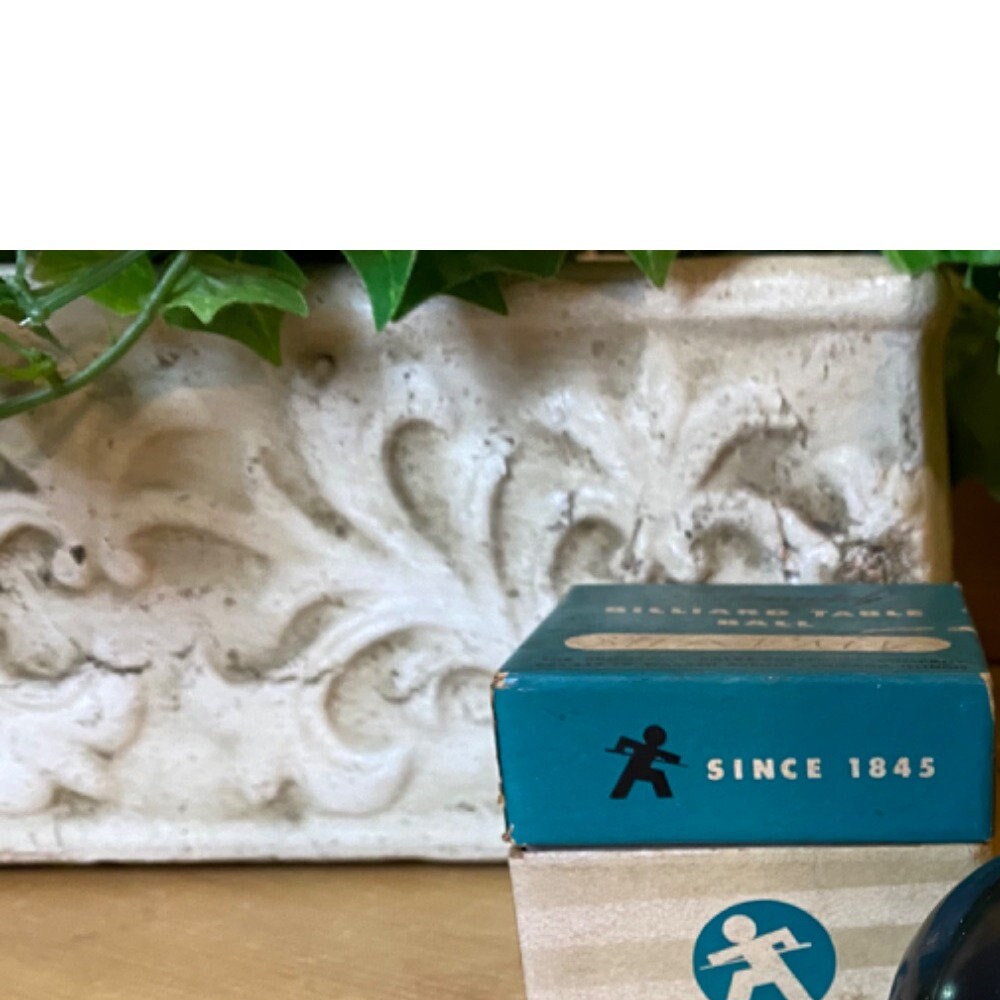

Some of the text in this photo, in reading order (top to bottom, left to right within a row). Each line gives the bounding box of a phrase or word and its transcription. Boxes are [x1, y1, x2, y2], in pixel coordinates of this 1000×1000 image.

[604, 605, 924, 619] BILLIARD TABLE
[706, 756, 937, 781] SINCE 1845
